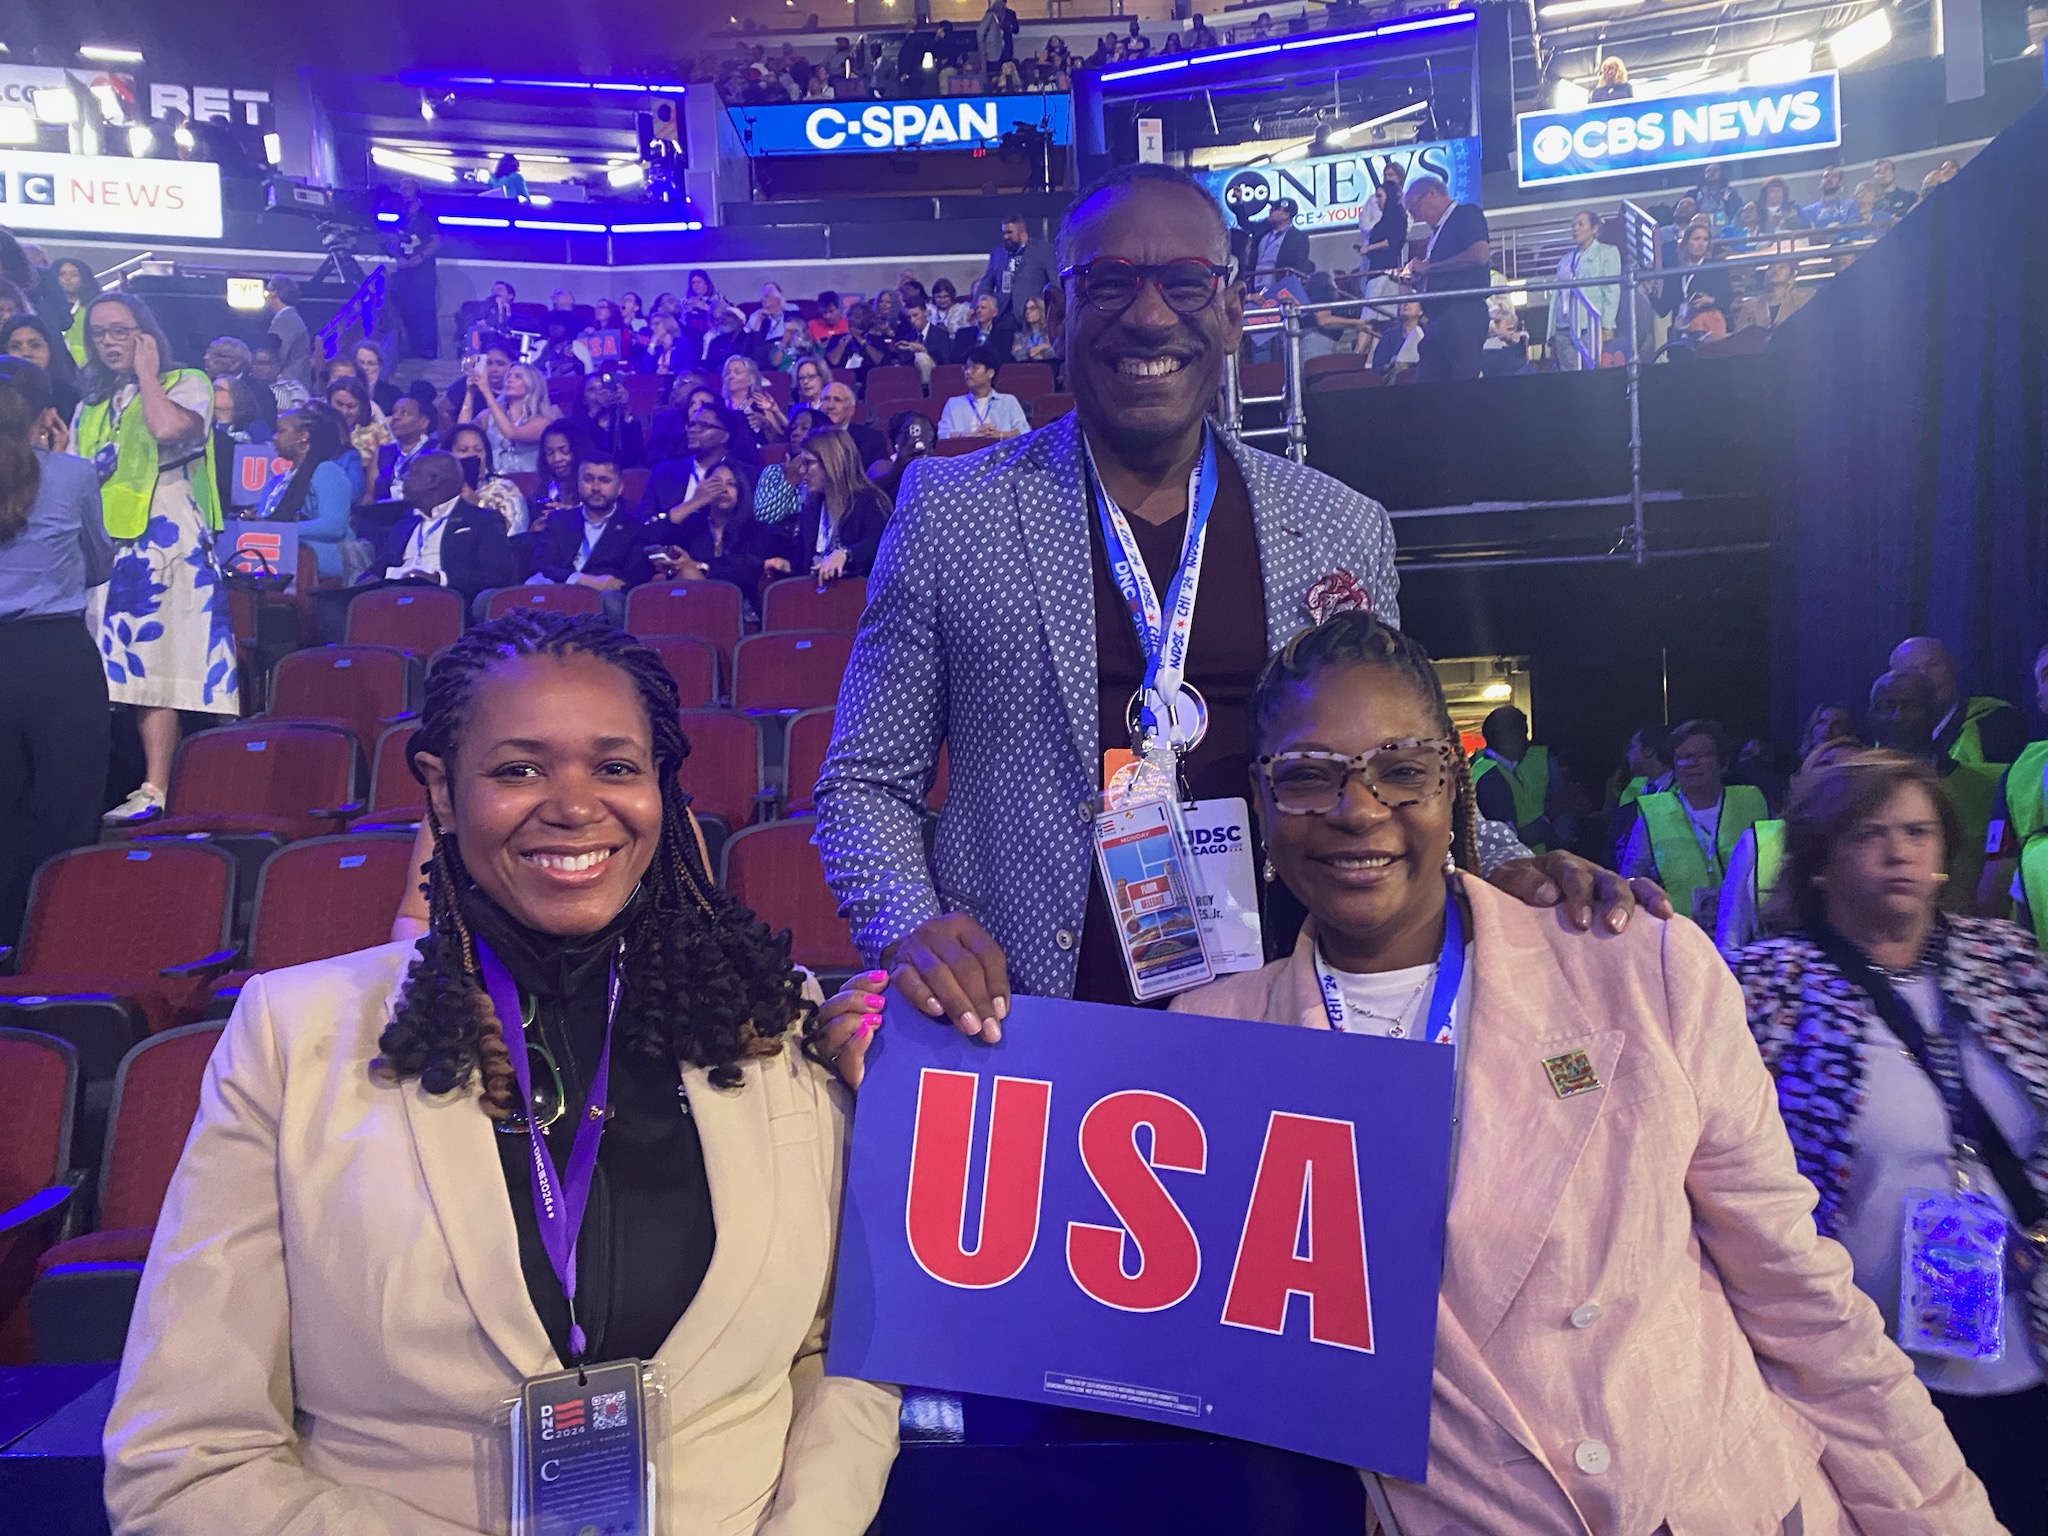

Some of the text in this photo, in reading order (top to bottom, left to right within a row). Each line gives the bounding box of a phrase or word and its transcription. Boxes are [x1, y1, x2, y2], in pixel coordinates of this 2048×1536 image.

[150, 83, 270, 125] BET
[1573, 91, 1821, 158] CBS NEWS
[1271, 146, 1450, 209] NEWS
[70, 179, 185, 210] NEWS
[1115, 560, 1137, 601] DNC
[1177, 595, 1192, 617] CHI
[1157, 806, 1165, 821] 1
[1120, 831, 1150, 843] MONDAY
[1183, 844, 1228, 857] CAGO
[1328, 998, 1343, 1022] CHI
[539, 1177, 554, 1206] 2024
[905, 1067, 1375, 1355] USA
[555, 1425, 586, 1439] 2024
[540, 1459, 561, 1482] C
